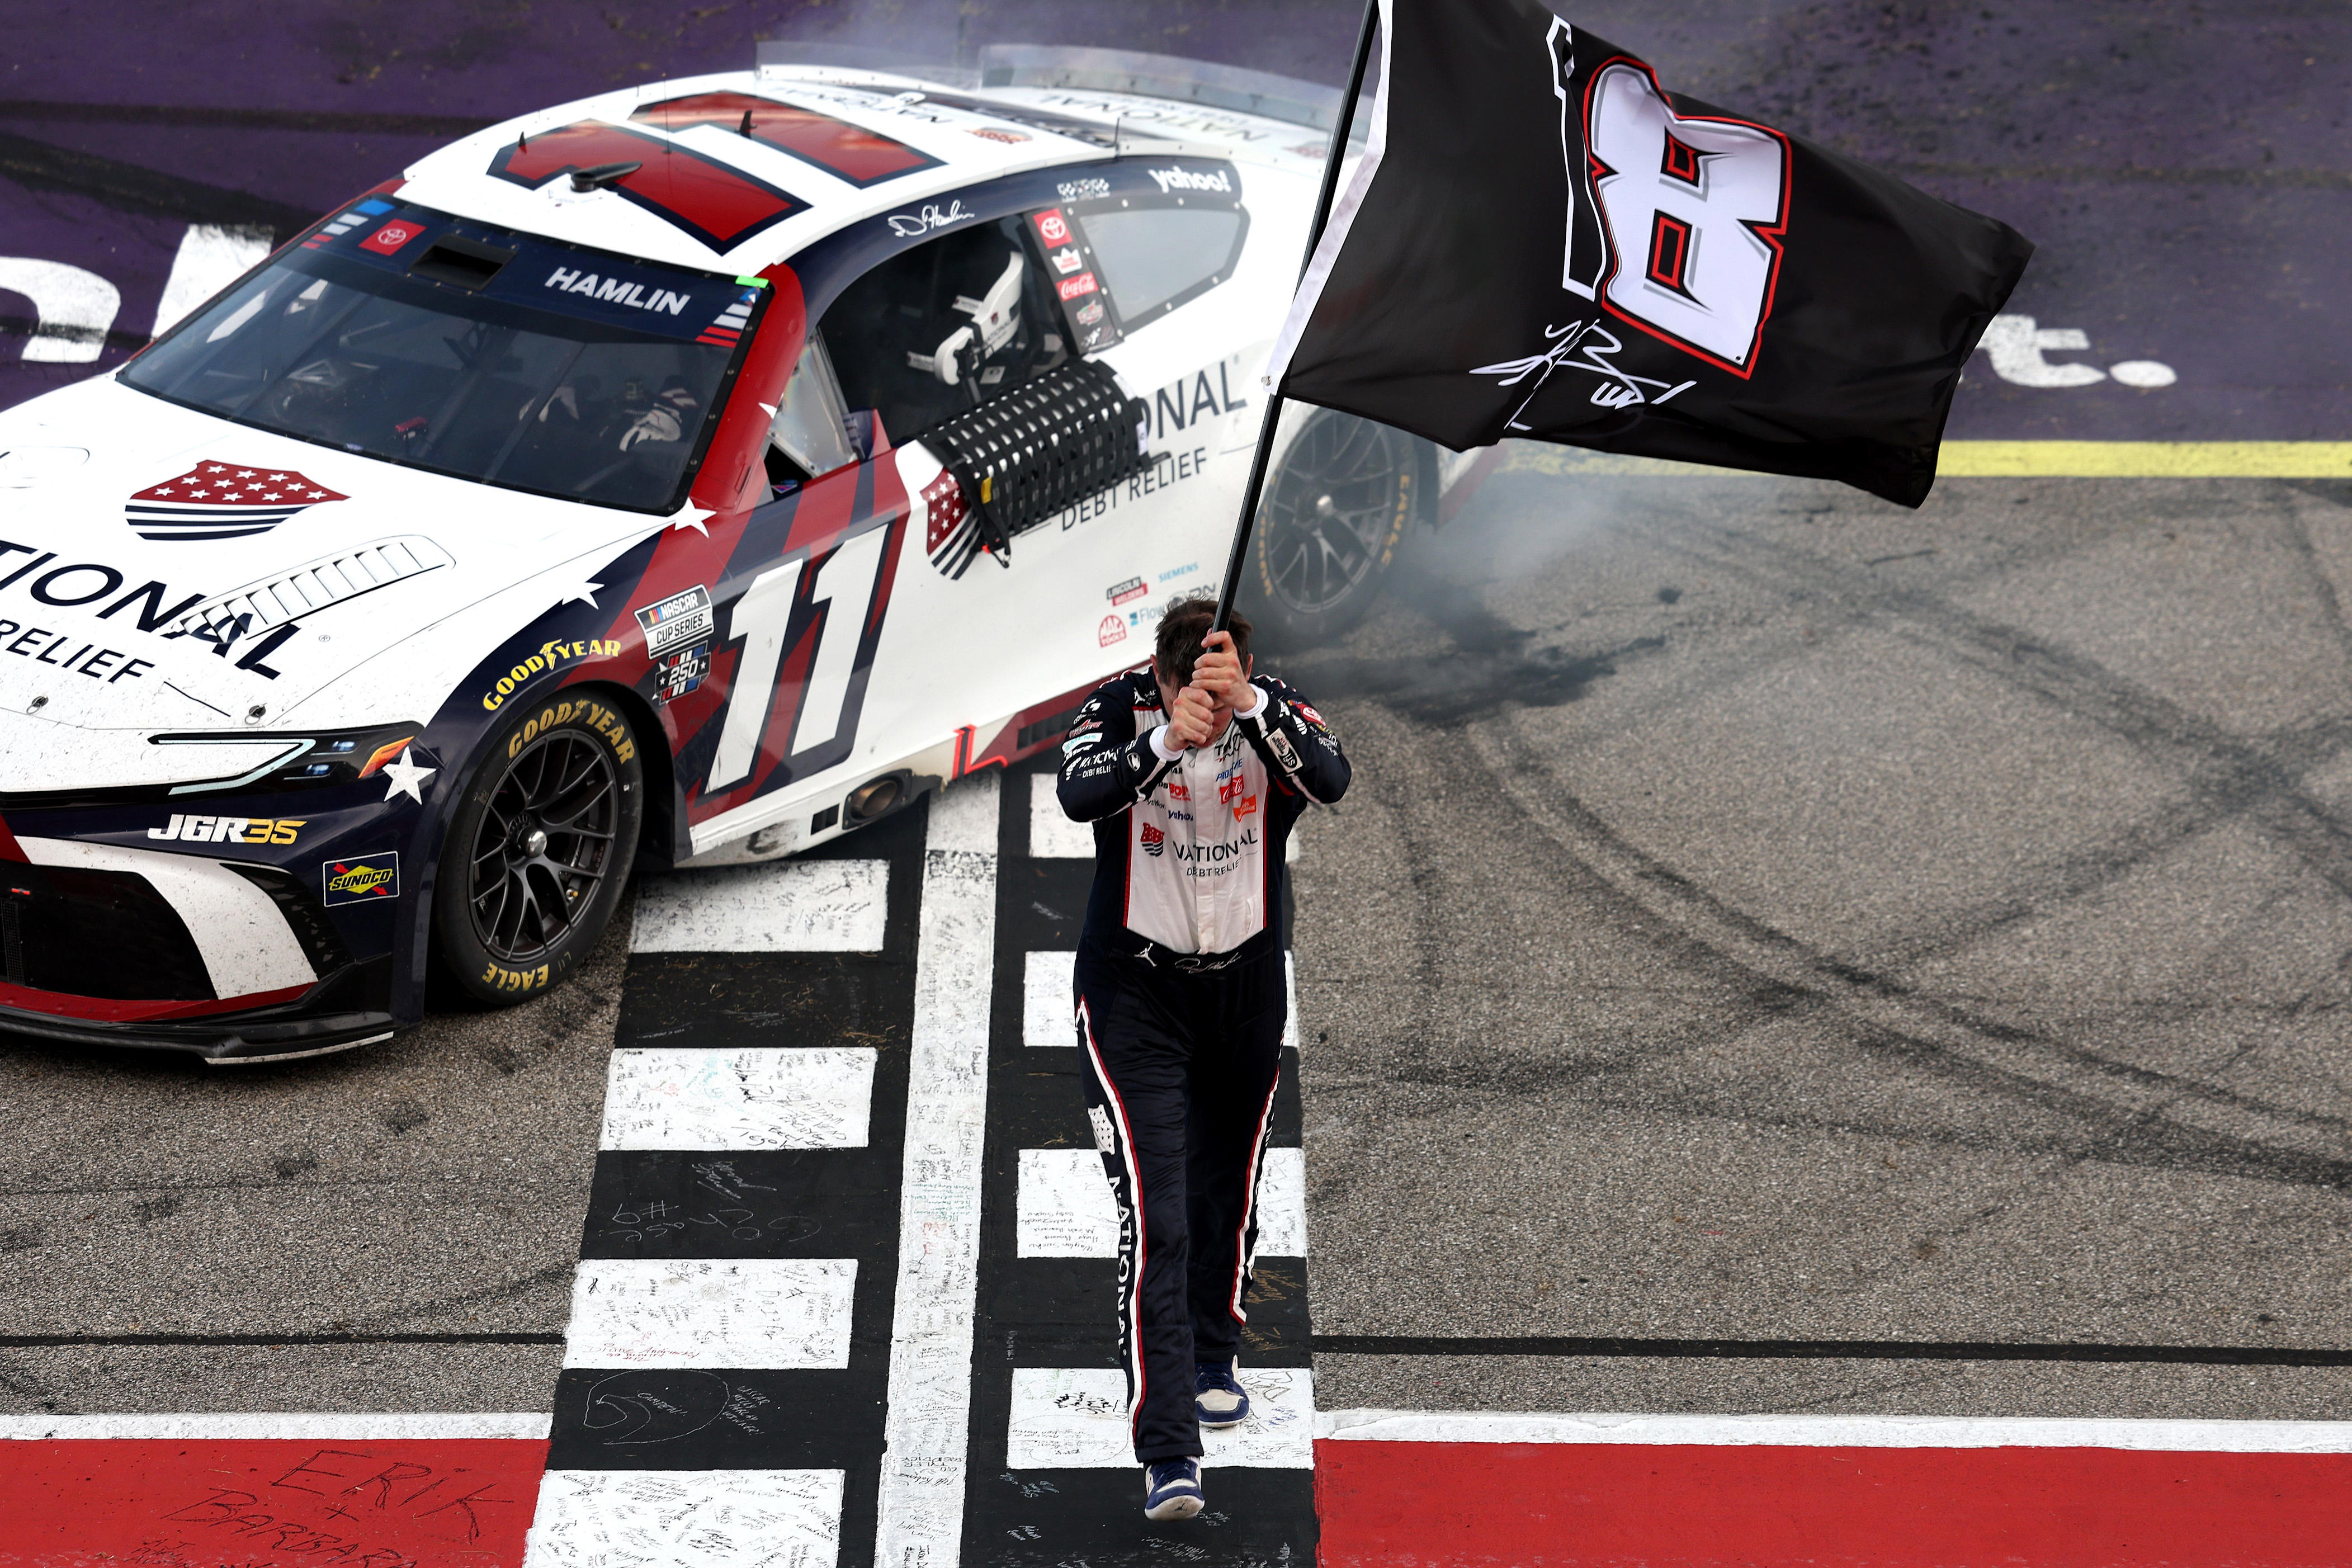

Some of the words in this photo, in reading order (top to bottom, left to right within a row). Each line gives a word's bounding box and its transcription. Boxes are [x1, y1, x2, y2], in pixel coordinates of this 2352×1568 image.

[1148, 166, 1232, 193] yahoo!
[545, 266, 691, 315] HAMLIN
[1062, 483, 1118, 532] DEBT
[1129, 447, 1208, 501] RELIEF
[1159, 562, 1199, 583] SIEMENS
[660, 592, 699, 621] NASCAR
[657, 626, 673, 644] CUP
[674, 613, 703, 638] SERIES
[668, 659, 698, 687] 250
[705, 523, 889, 795] 11
[1173, 829, 1258, 862] NATIONAL
[330, 868, 393, 890] SUNOCO
[1186, 867, 1213, 877] DEBT
[482, 961, 550, 991] EAGLE
[271, 1449, 515, 1545] ERIK
